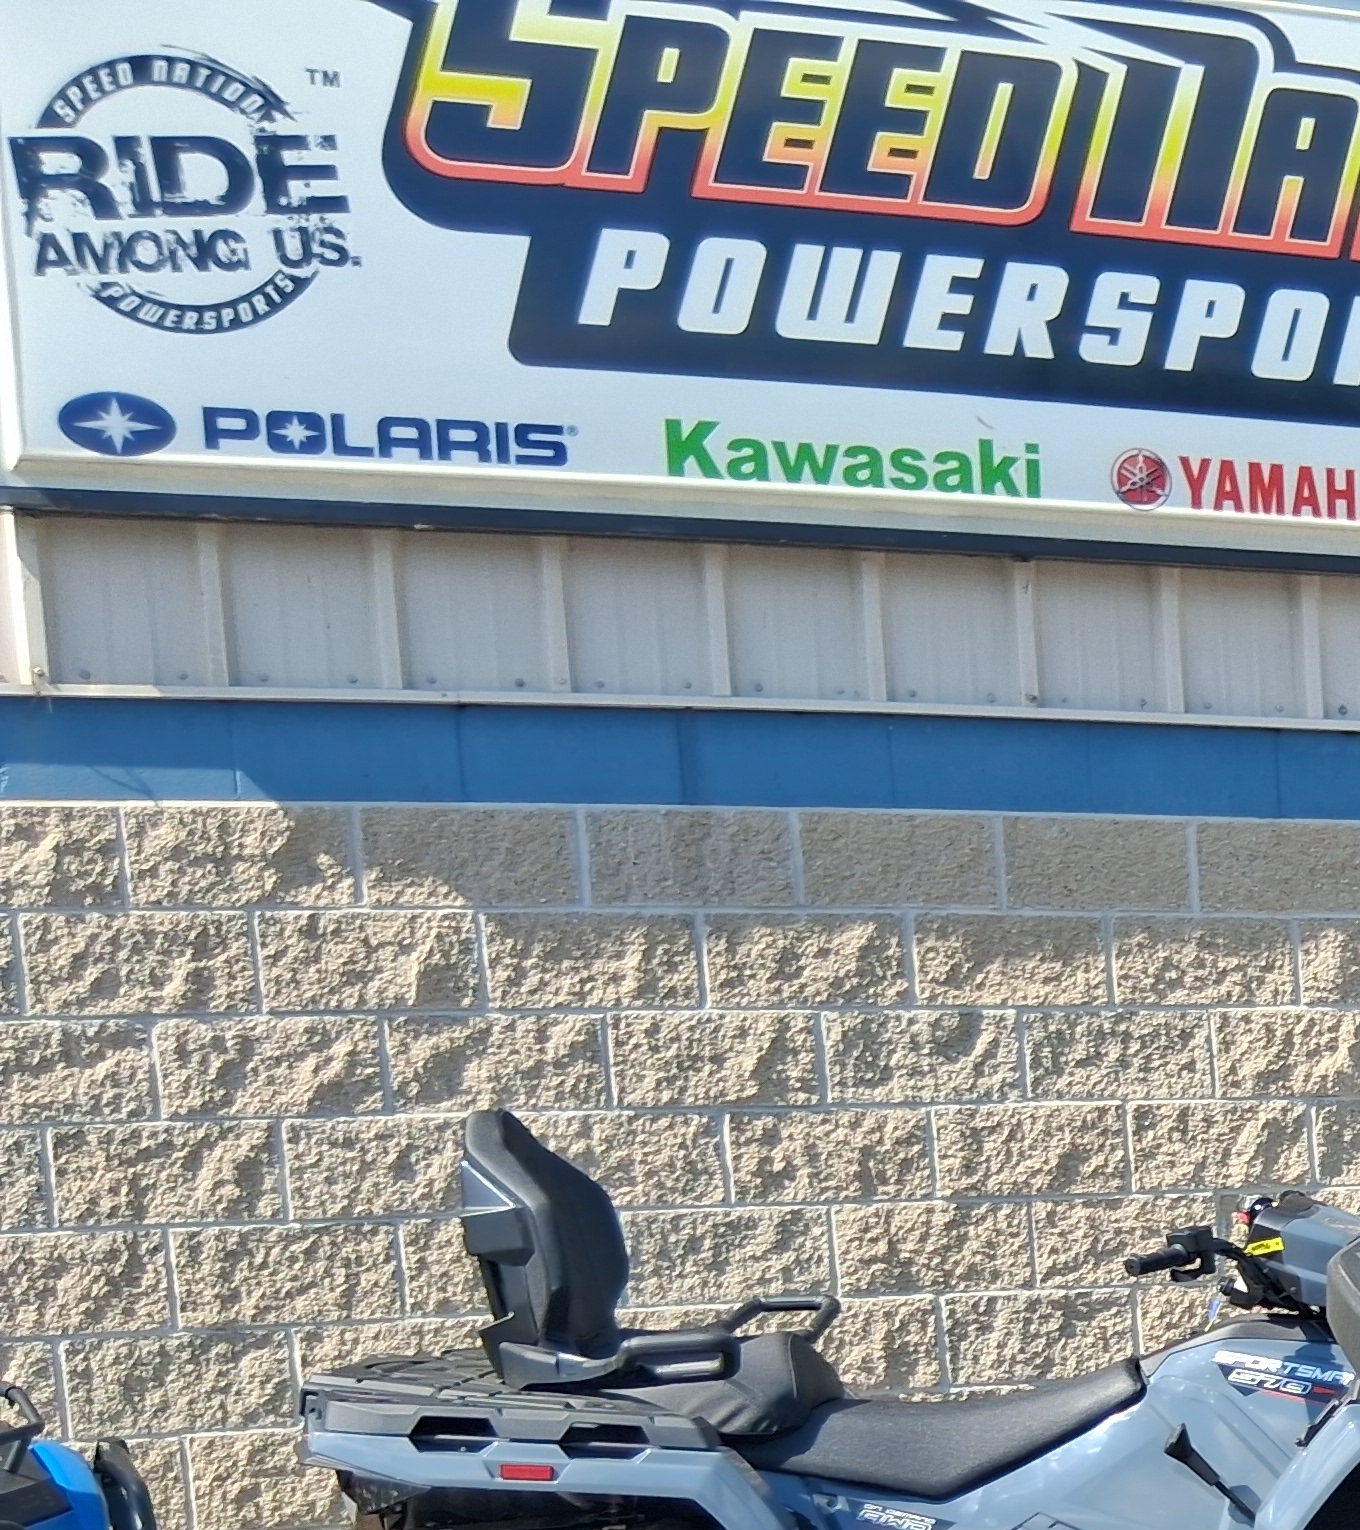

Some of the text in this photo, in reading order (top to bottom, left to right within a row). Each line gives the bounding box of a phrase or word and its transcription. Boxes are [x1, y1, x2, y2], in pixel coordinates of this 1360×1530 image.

[52, 57, 266, 124] SPEED NATION
[6, 133, 351, 221] RIDE
[34, 228, 252, 277] AMONG
[101, 271, 297, 330] POWERSPORTS
[201, 405, 570, 467] POLARIS
[664, 417, 1042, 500] Kawasaki
